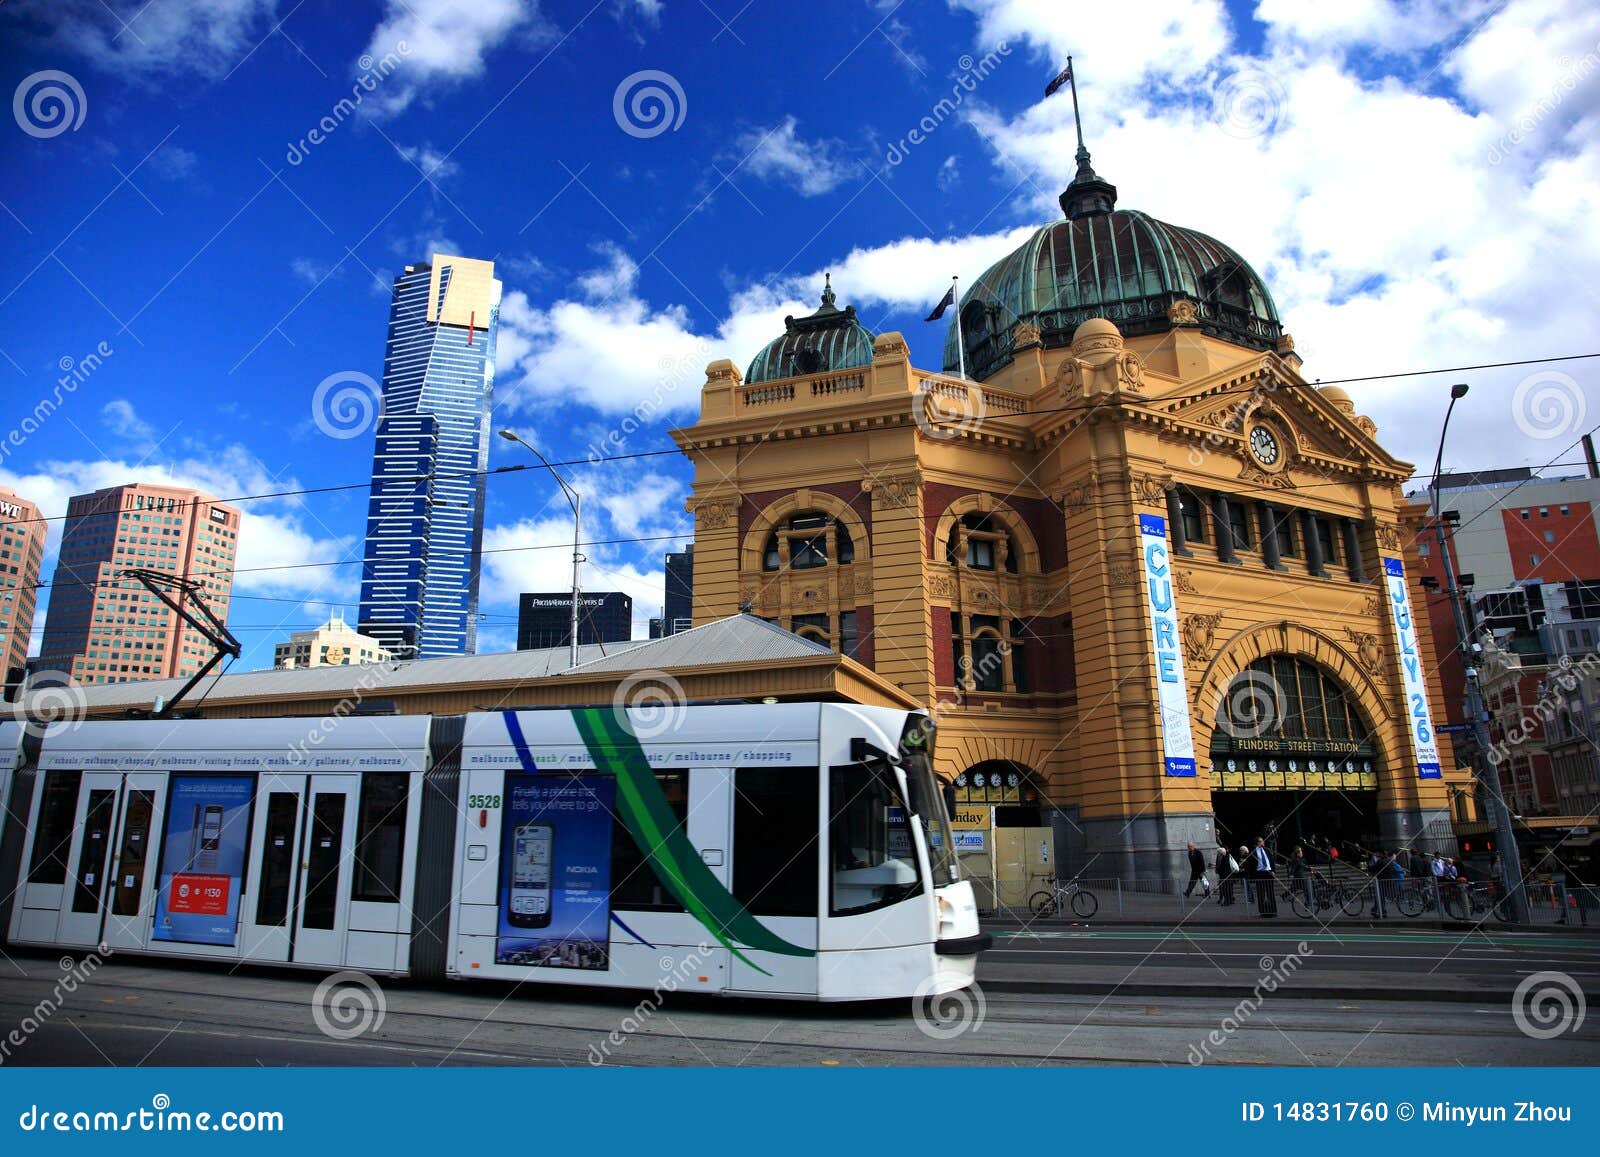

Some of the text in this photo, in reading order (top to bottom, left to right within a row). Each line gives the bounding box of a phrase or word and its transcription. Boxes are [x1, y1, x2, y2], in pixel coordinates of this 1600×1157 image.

[0, 500, 22, 518] WT
[1145, 542, 1178, 683] CURE
[1391, 580, 1417, 683] JULY
[1410, 692, 1431, 743] 26
[1238, 739, 1360, 753] FLINDERS STREET STATION
[471, 754, 519, 763] melbourne
[675, 752, 731, 761] melbourne
[743, 751, 793, 762] shopping
[468, 794, 501, 809] 3528
[954, 811, 984, 825] nday
